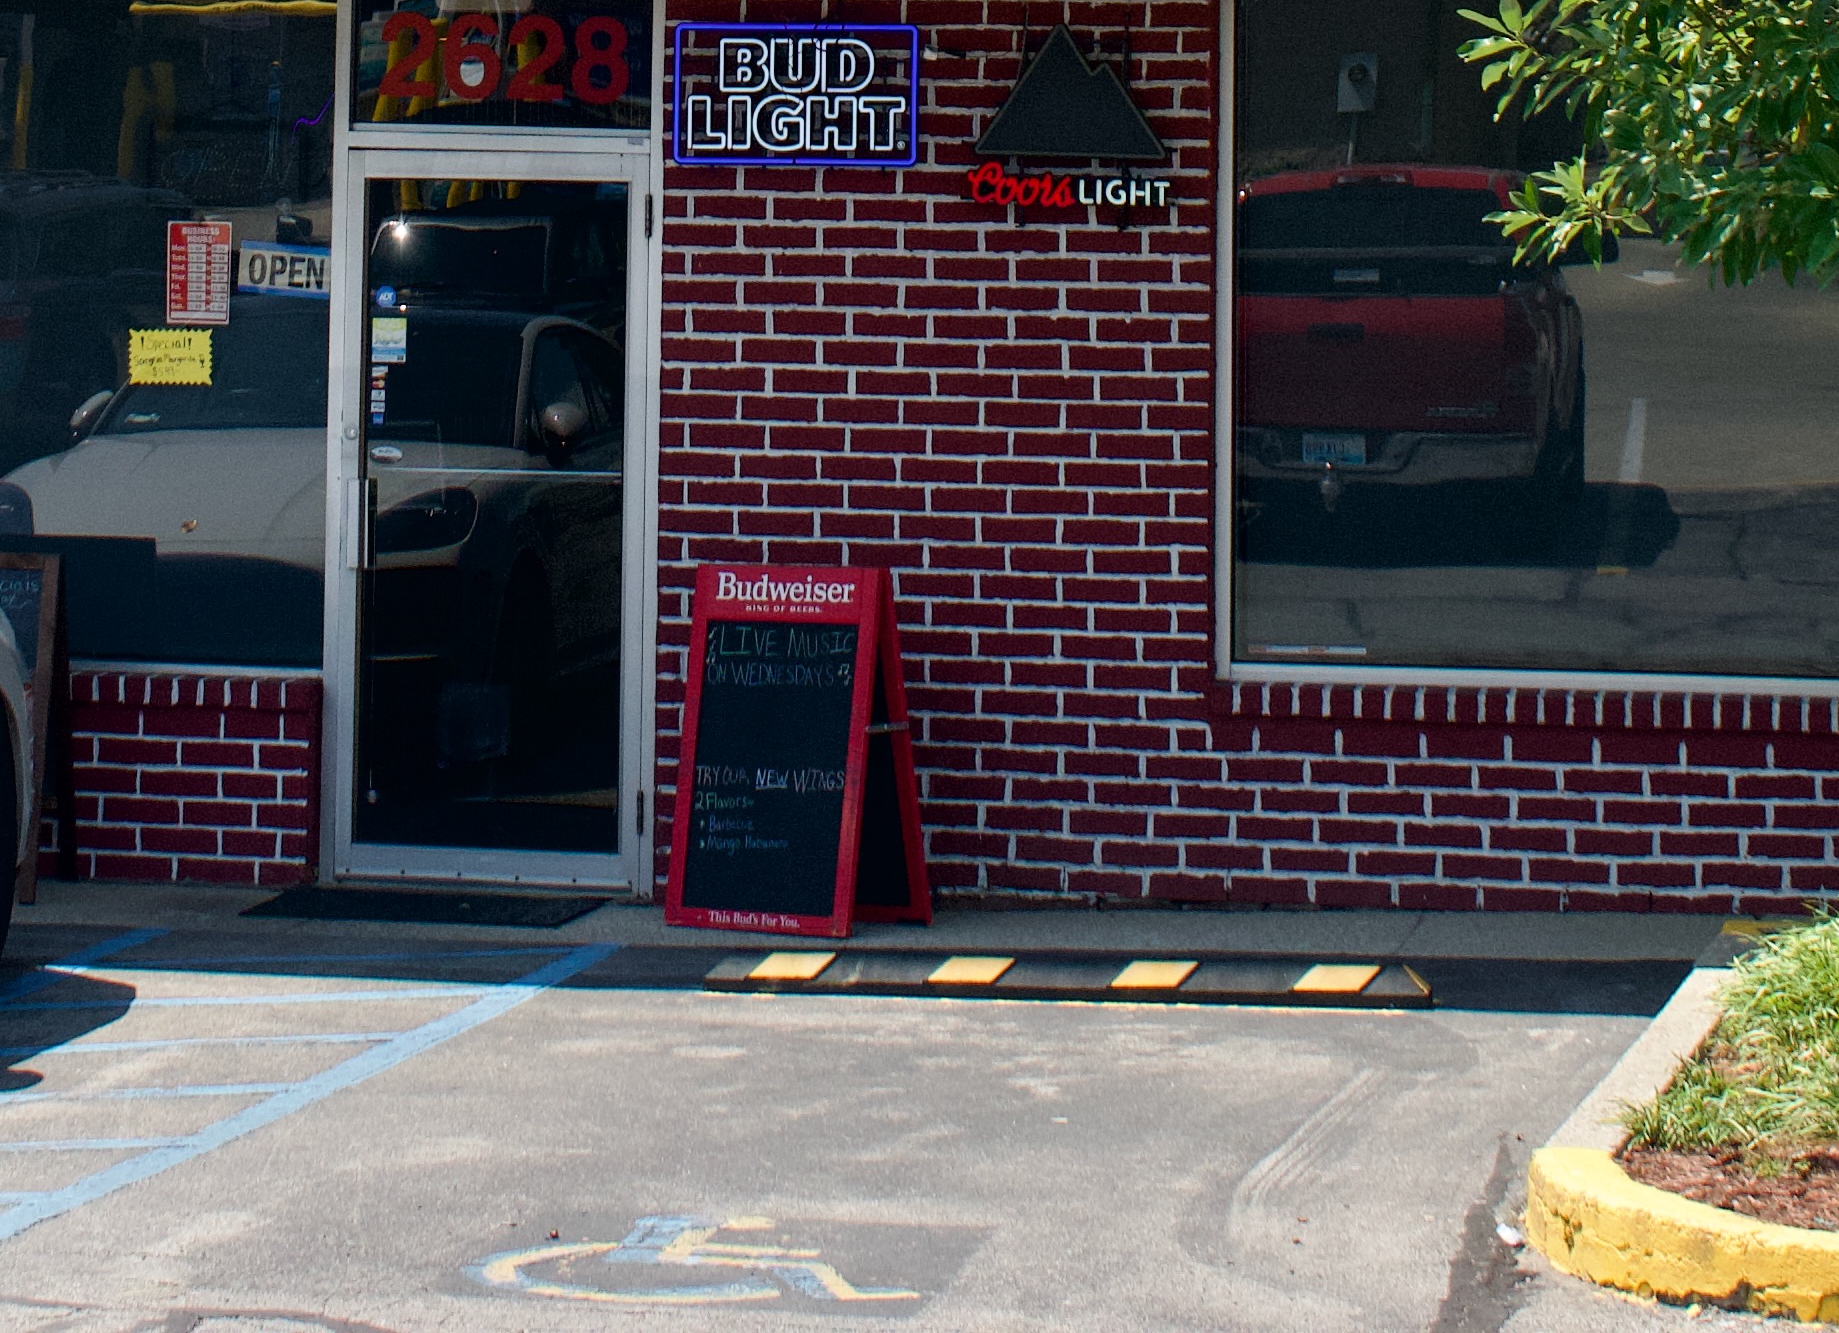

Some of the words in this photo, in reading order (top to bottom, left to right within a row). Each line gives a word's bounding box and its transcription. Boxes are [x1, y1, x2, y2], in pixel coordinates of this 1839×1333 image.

[378, 11, 629, 105] 2628
[717, 37, 875, 94] BUD
[686, 95, 906, 152] LIGHT
[967, 161, 1076, 208] Coors
[1078, 178, 1171, 208] LIGHT
[248, 253, 325, 290] OPEN
[378, 292, 394, 301] ADT
[716, 571, 856, 603] Budweiser
[720, 624, 778, 657] LIVE
[787, 627, 856, 658] MUSIC
[707, 663, 727, 685] ON
[731, 661, 834, 687] WEDNESDAYS
[695, 765, 721, 786] TRY
[723, 765, 750, 785] OUR
[755, 767, 789, 789] NEW
[793, 767, 846, 794] WINGS
[694, 791, 704, 810] 2
[708, 910, 730, 923] This
[733, 911, 759, 925] Bud's
[761, 913, 778, 927] For
